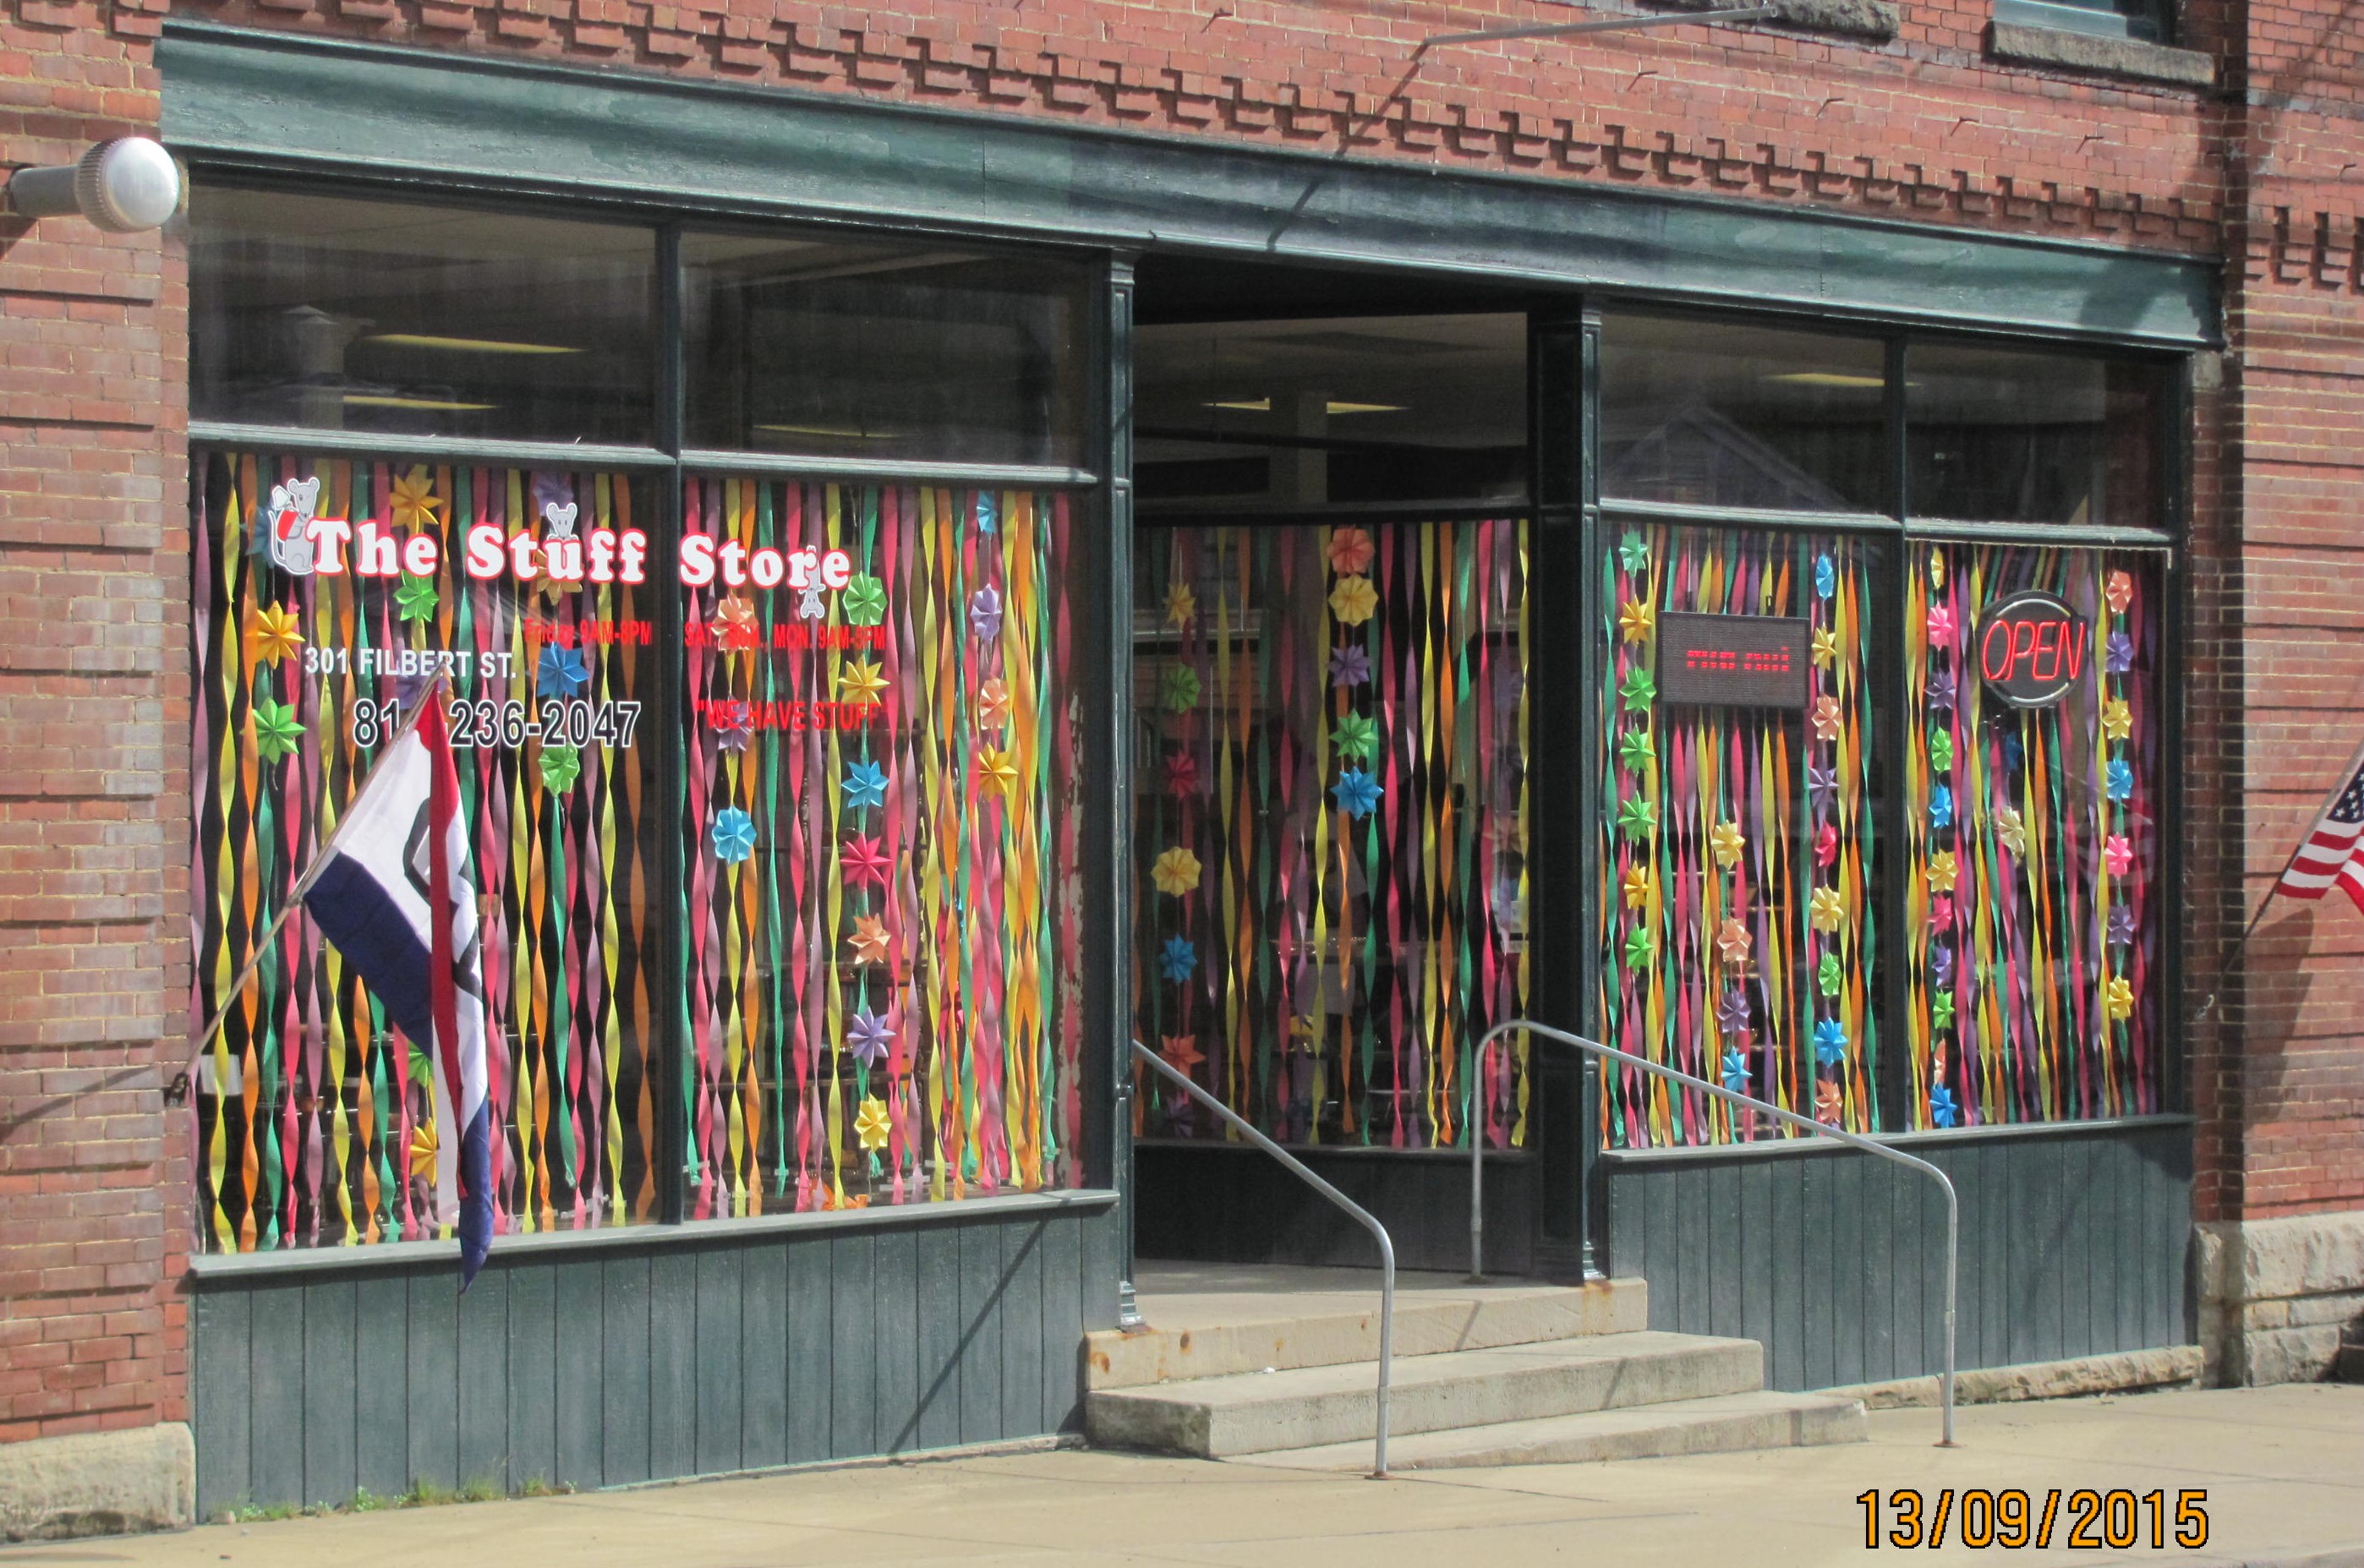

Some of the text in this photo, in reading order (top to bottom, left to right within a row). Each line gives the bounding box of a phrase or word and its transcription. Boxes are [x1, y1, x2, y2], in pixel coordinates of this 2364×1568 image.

[305, 516, 851, 590] The Stuff Store
[305, 647, 517, 678] 301 FILBERT ST.
[1983, 620, 2086, 681] OPEN
[746, 701, 807, 730] HAVE
